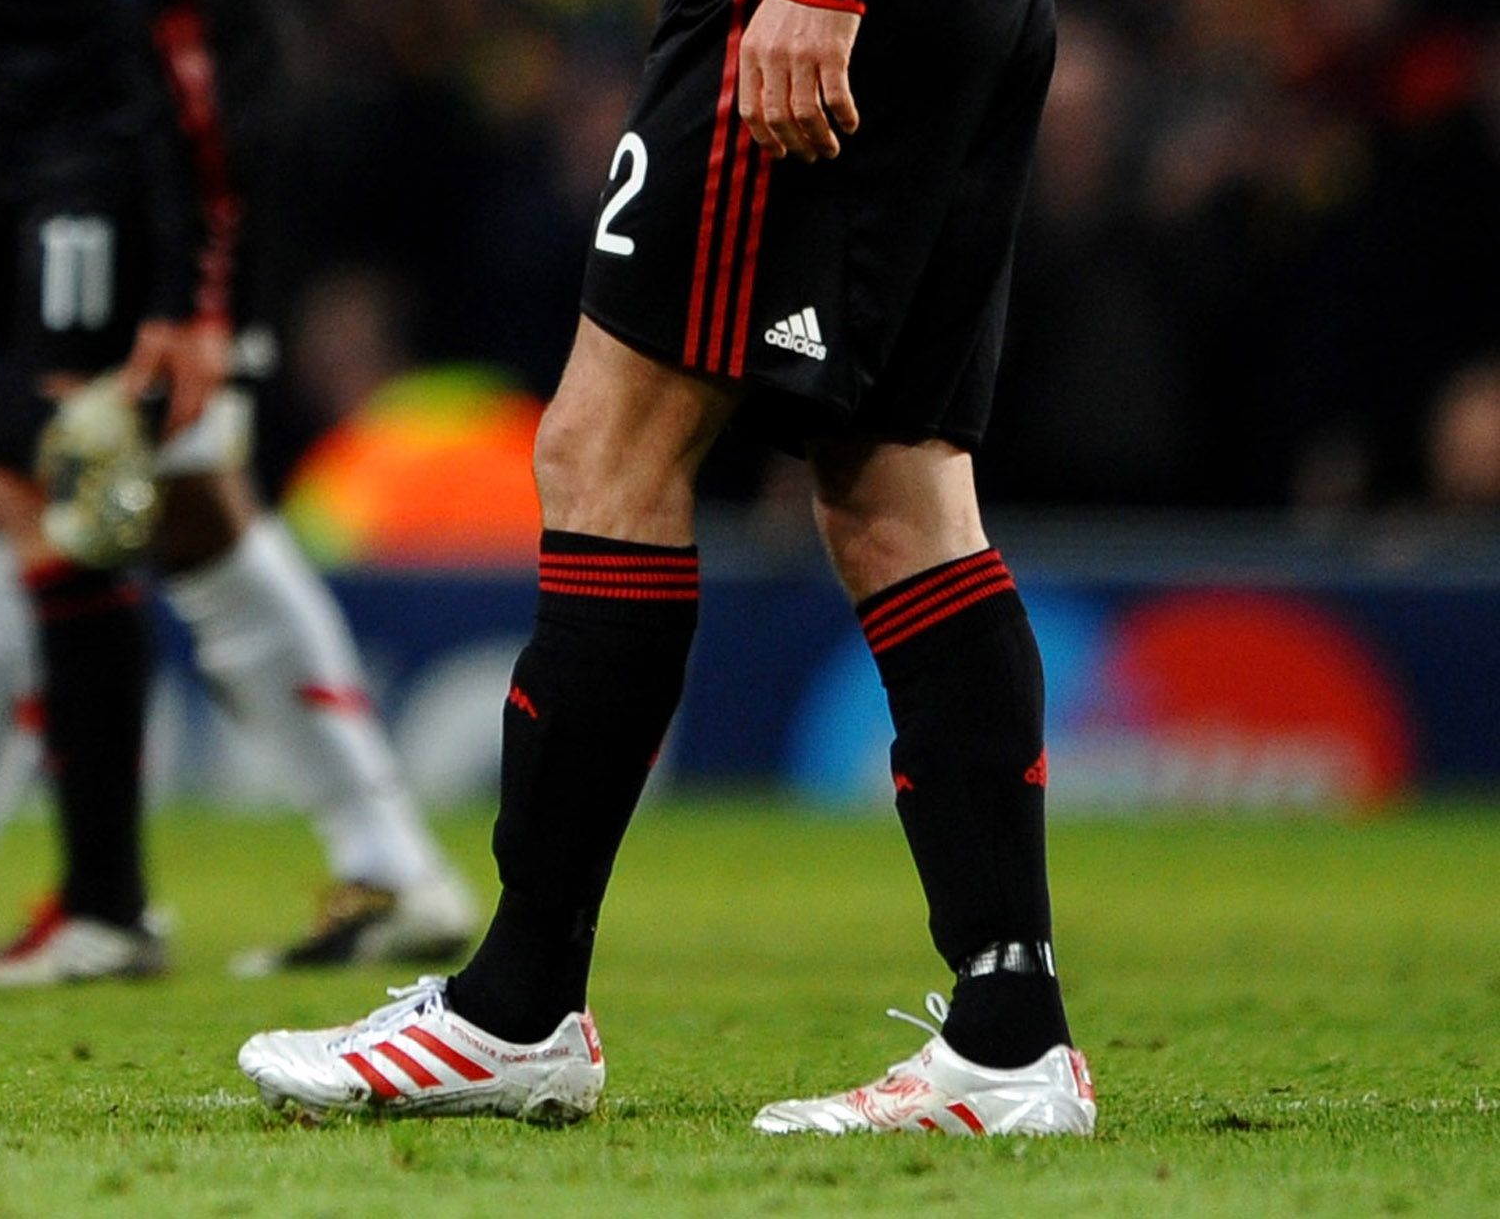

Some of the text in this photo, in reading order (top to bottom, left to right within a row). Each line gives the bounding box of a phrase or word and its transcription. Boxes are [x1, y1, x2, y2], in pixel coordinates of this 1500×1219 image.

[595, 131, 648, 257] 2
[40, 215, 115, 332] 11
[764, 327, 827, 362] adidas
